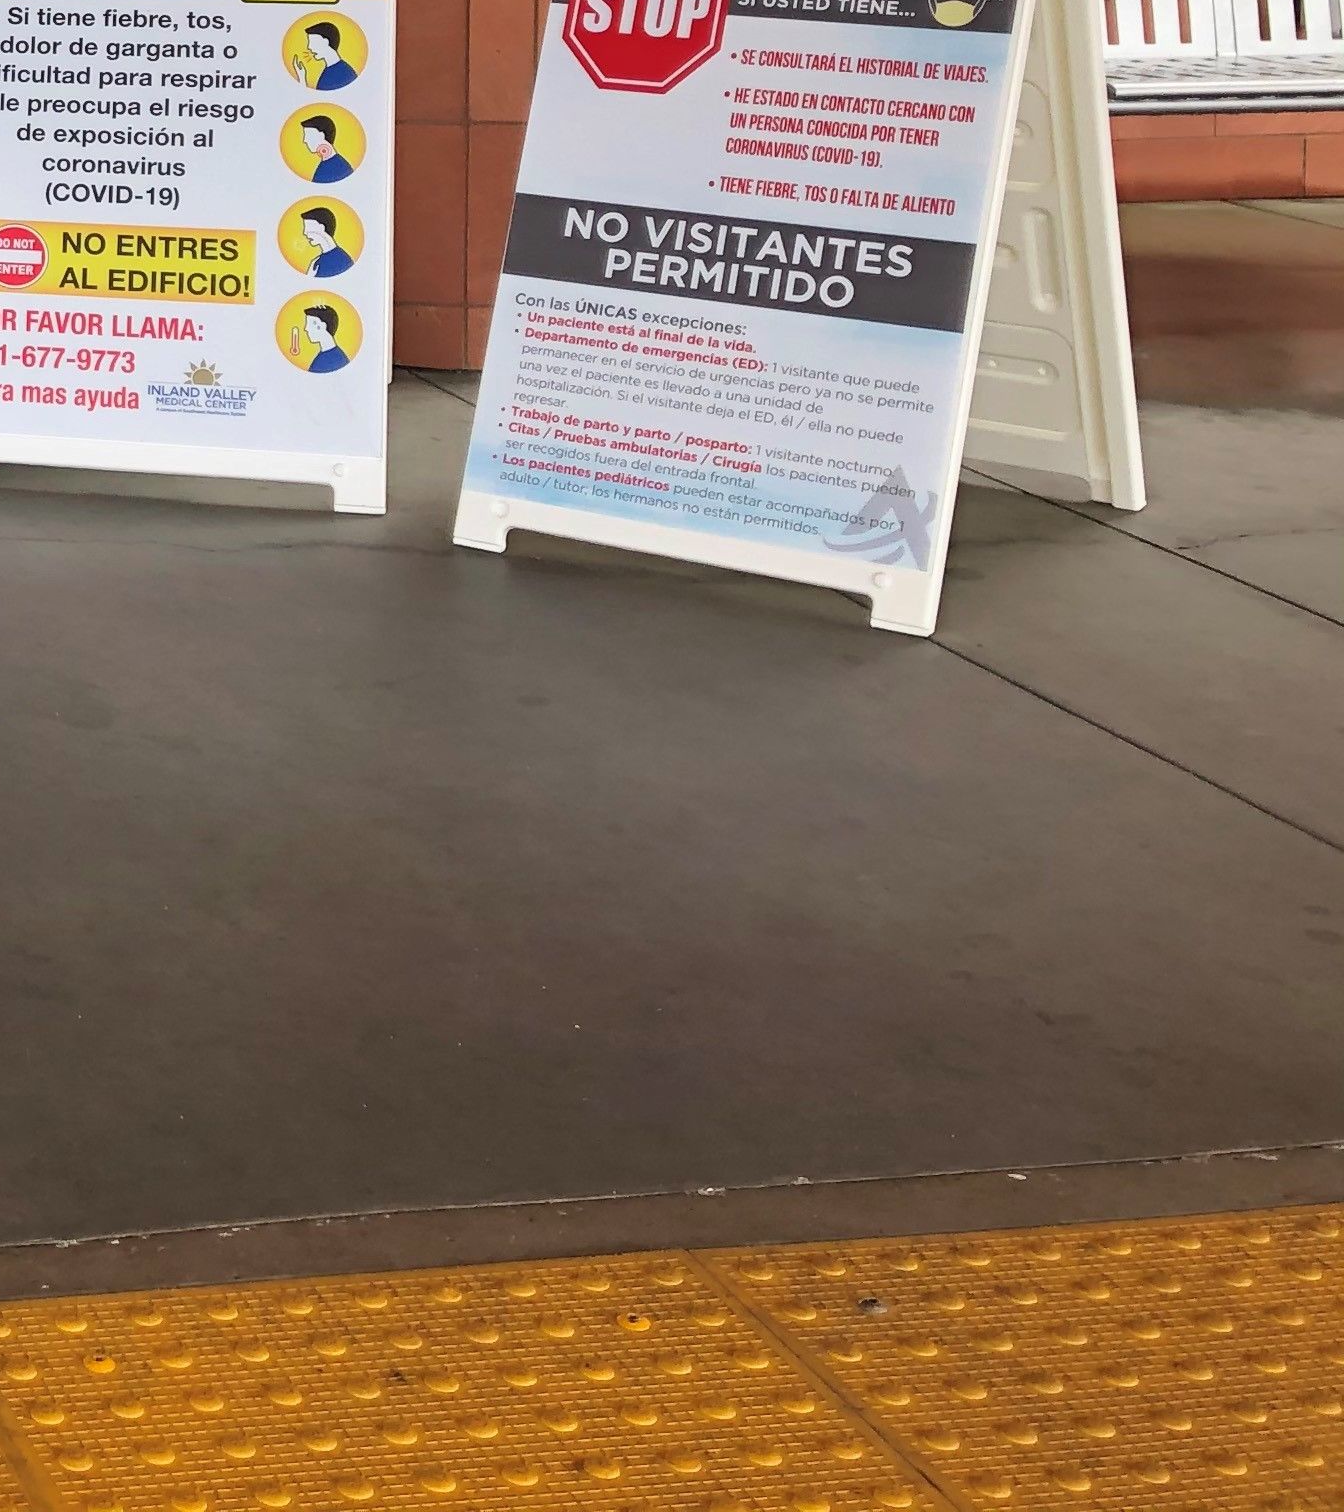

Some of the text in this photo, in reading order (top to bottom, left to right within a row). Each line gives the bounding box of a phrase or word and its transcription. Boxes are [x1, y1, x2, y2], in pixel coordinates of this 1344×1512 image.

[7, 7, 231, 32] Si tiene fiebre, tos,
[0, 35, 237, 61] dolor de garganta o
[99, 71, 152, 88] para
[161, 70, 256, 91] respirar
[741, 49, 990, 84] SE CONSULTARÁ EL HISTORIAL DE VIAJES.
[62, 231, 238, 261] NO ENTRES
[564, 207, 912, 276] NO VISITANTES
[59, 267, 249, 297] AL EDIFICIO!
[602, 249, 853, 307] PERMITIDO
[26, 310, 102, 335] FAVOR
[112, 315, 203, 341] LLAMA:
[515, 293, 746, 335] Con las ÚNICAS excepciones:
[527, 311, 755, 353] Un paciente está al final de la vida.
